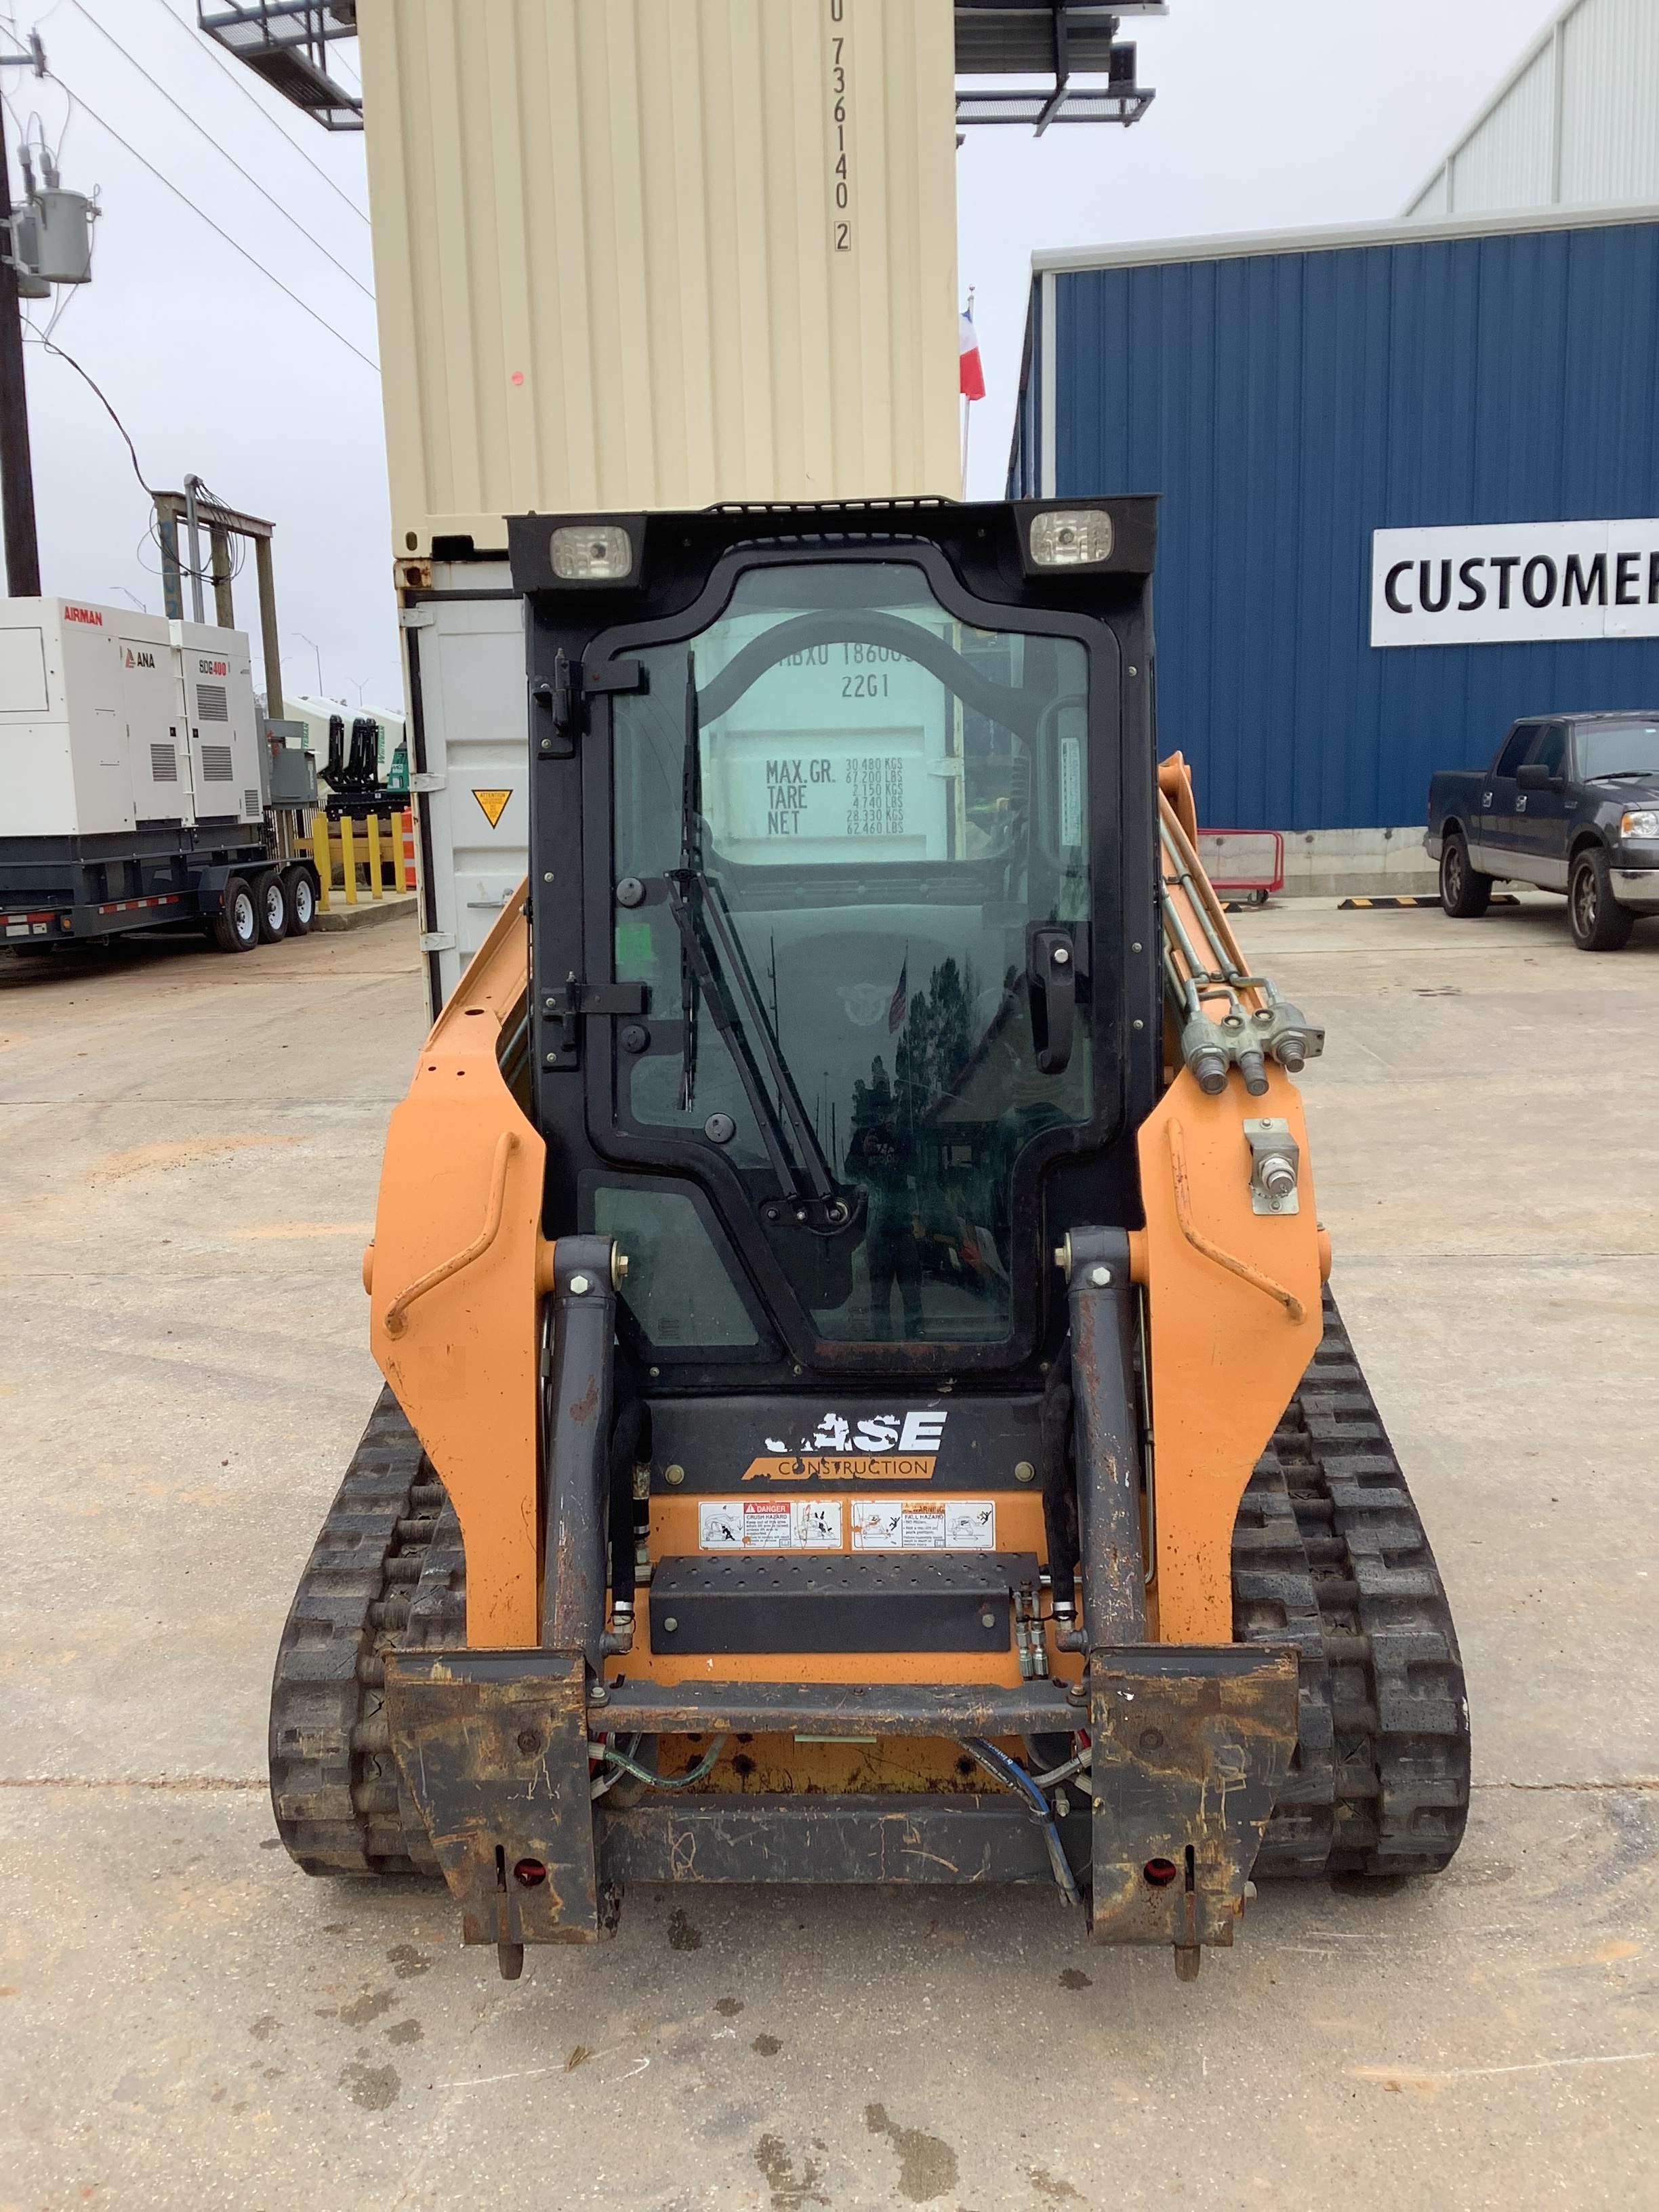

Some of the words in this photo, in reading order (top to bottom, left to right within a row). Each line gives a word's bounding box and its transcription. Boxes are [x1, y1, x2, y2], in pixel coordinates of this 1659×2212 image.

[836, 223, 849, 249] 2
[64, 606, 102, 626] AIRMAN
[137, 651, 155, 668] ANA
[199, 659, 226, 676] SDG400
[842, 674, 888, 698] 22G1
[885, 758, 903, 770] KGS
[885, 771, 903, 783] LBS
[767, 785, 808, 810] TARE
[886, 783, 903, 796] KGS
[886, 796, 903, 808] LBS
[768, 811, 800, 834] NET
[886, 808, 903, 821] KGS
[886, 821, 903, 834] LBS
[764, 1411, 947, 1452] ASE
[779, 1460, 928, 1475] CONSTRUCTION
[756, 1505, 786, 1513] DANGER
